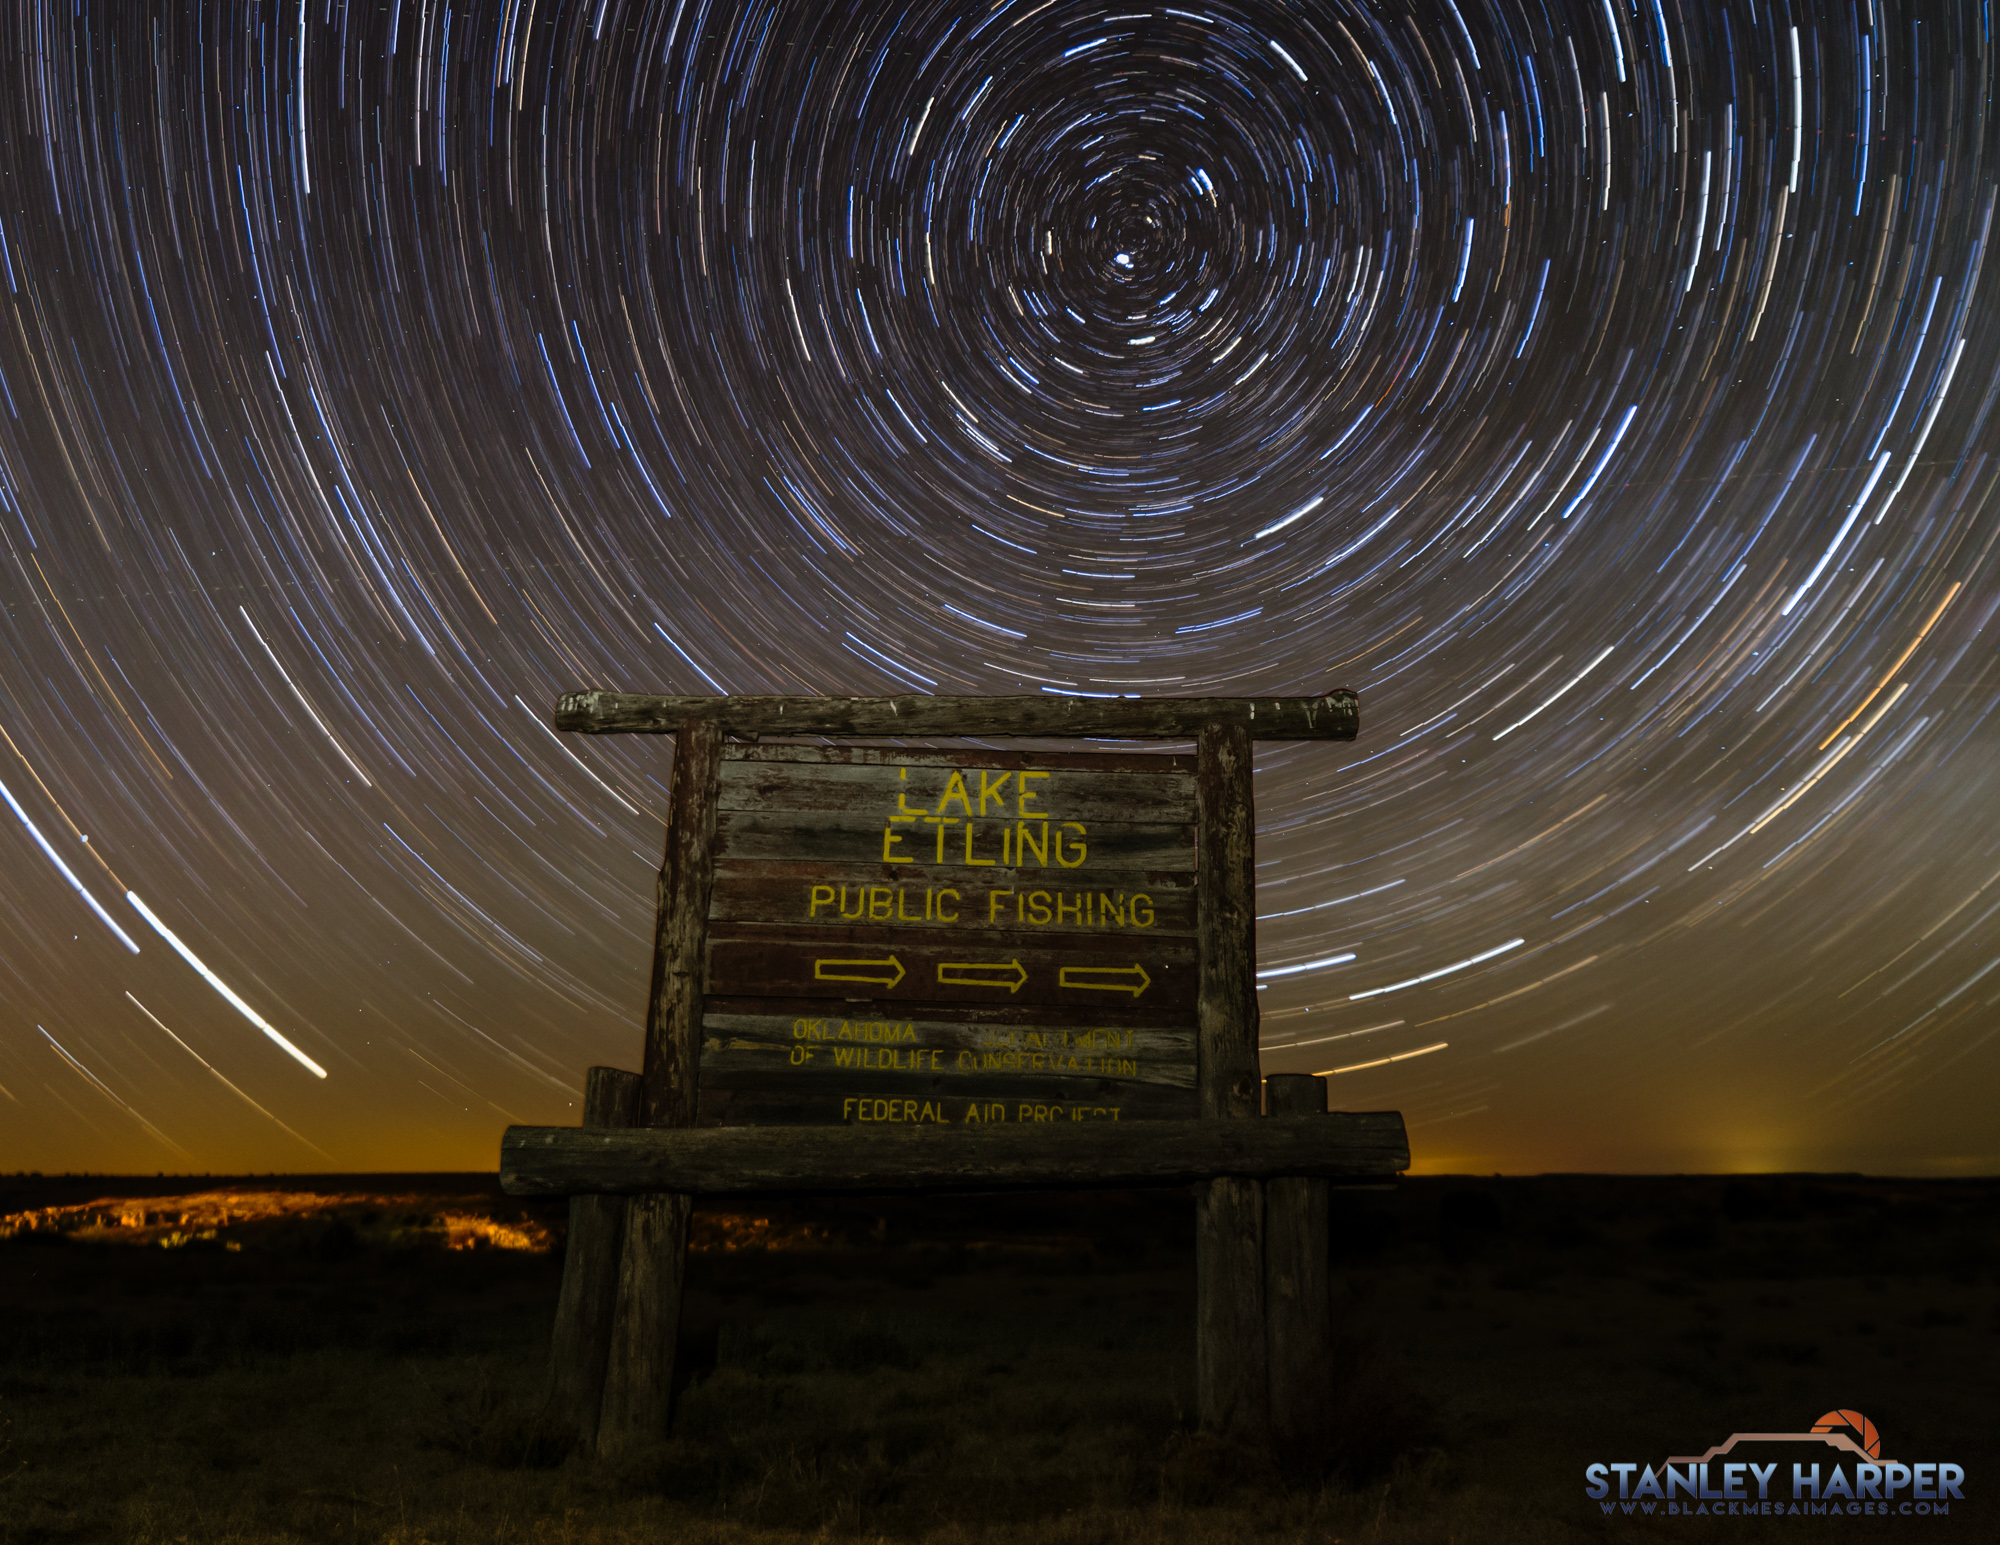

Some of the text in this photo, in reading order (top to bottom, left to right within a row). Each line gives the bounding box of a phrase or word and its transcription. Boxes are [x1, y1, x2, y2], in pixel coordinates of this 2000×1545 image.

[898, 768, 1050, 819] LAKE
[883, 815, 1088, 868] ETLING
[810, 885, 1155, 928] PUBLIC FISHING
[793, 1018, 916, 1042] OKLAHOMA
[790, 1045, 819, 1066] OF
[834, 1046, 944, 1070] WILDLIFE
[843, 1098, 950, 1123] FEDERAL
[965, 1103, 1005, 1123] AID
